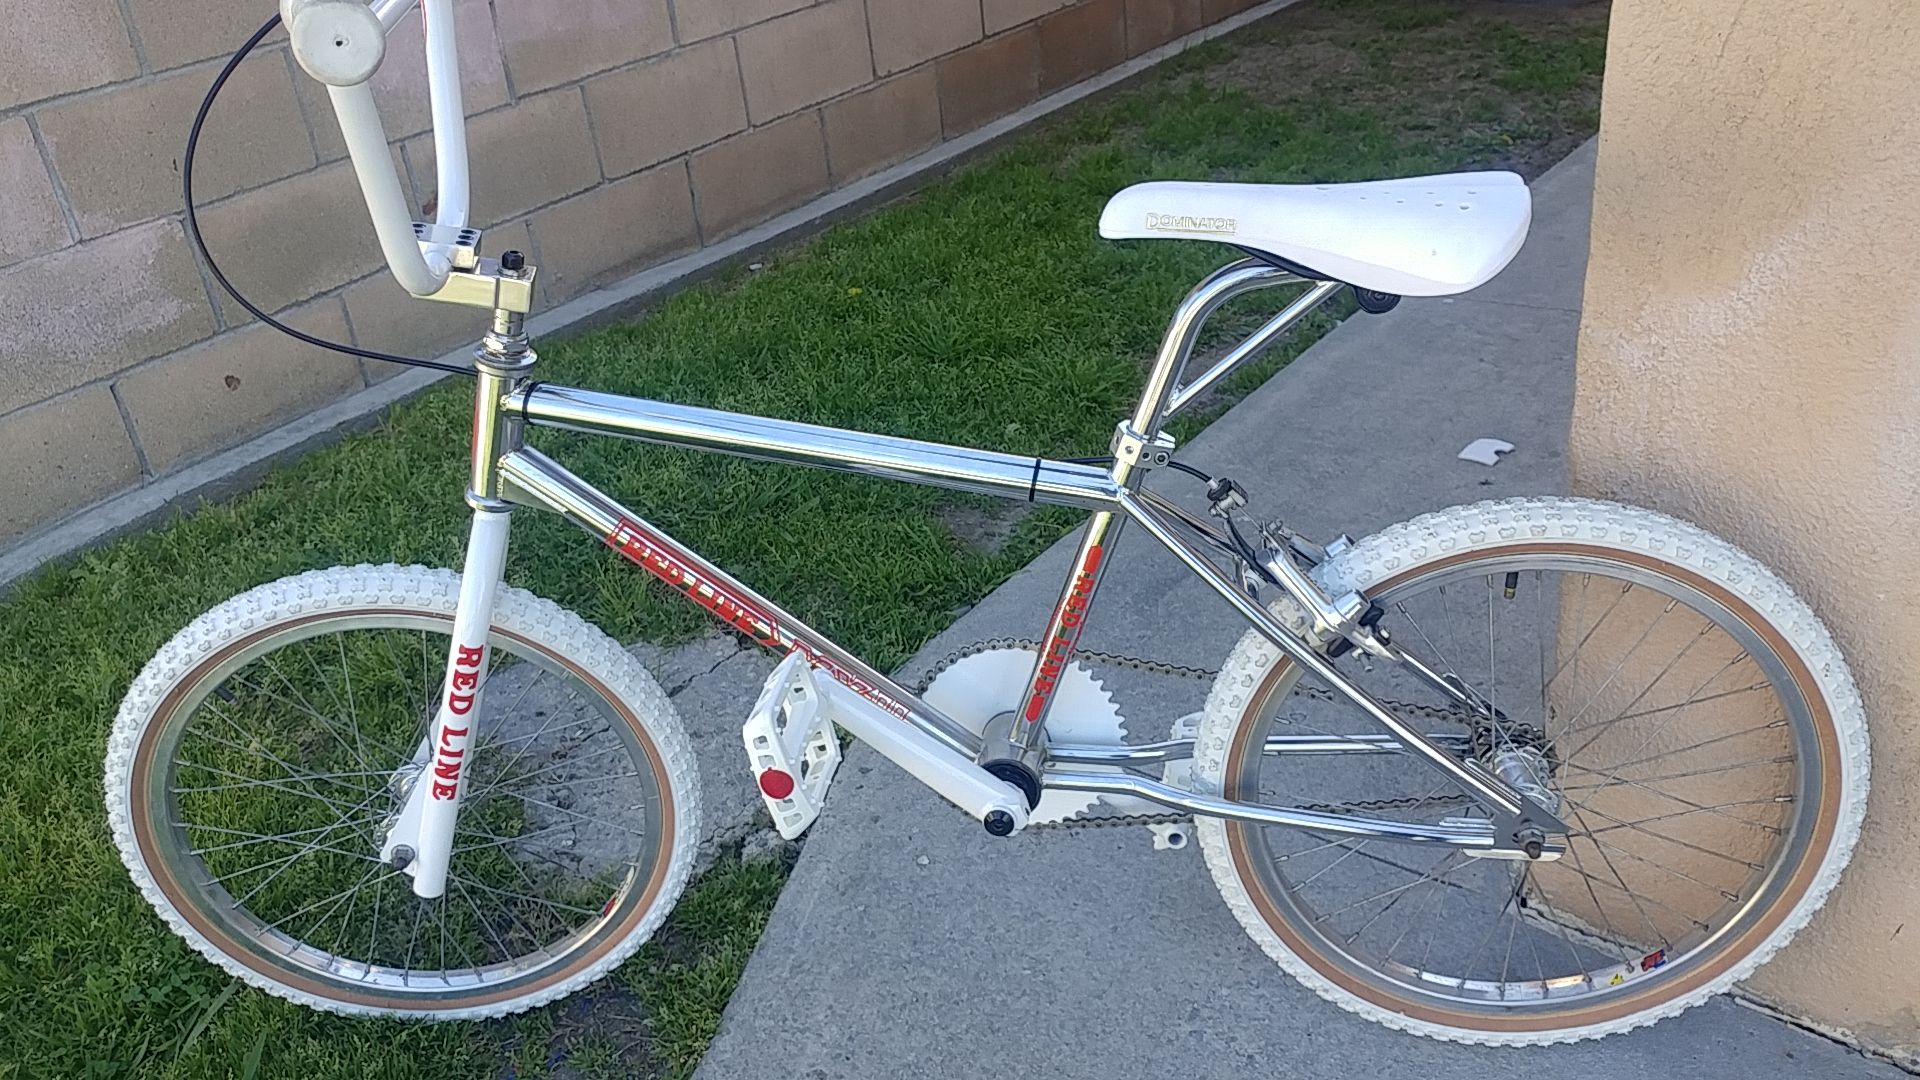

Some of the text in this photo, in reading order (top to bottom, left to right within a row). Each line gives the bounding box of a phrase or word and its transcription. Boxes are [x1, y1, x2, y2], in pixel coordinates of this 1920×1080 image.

[1145, 212, 1237, 231] DOMINATOR
[1032, 573, 1095, 697] RED LINE
[432, 643, 485, 801] RED LINE
